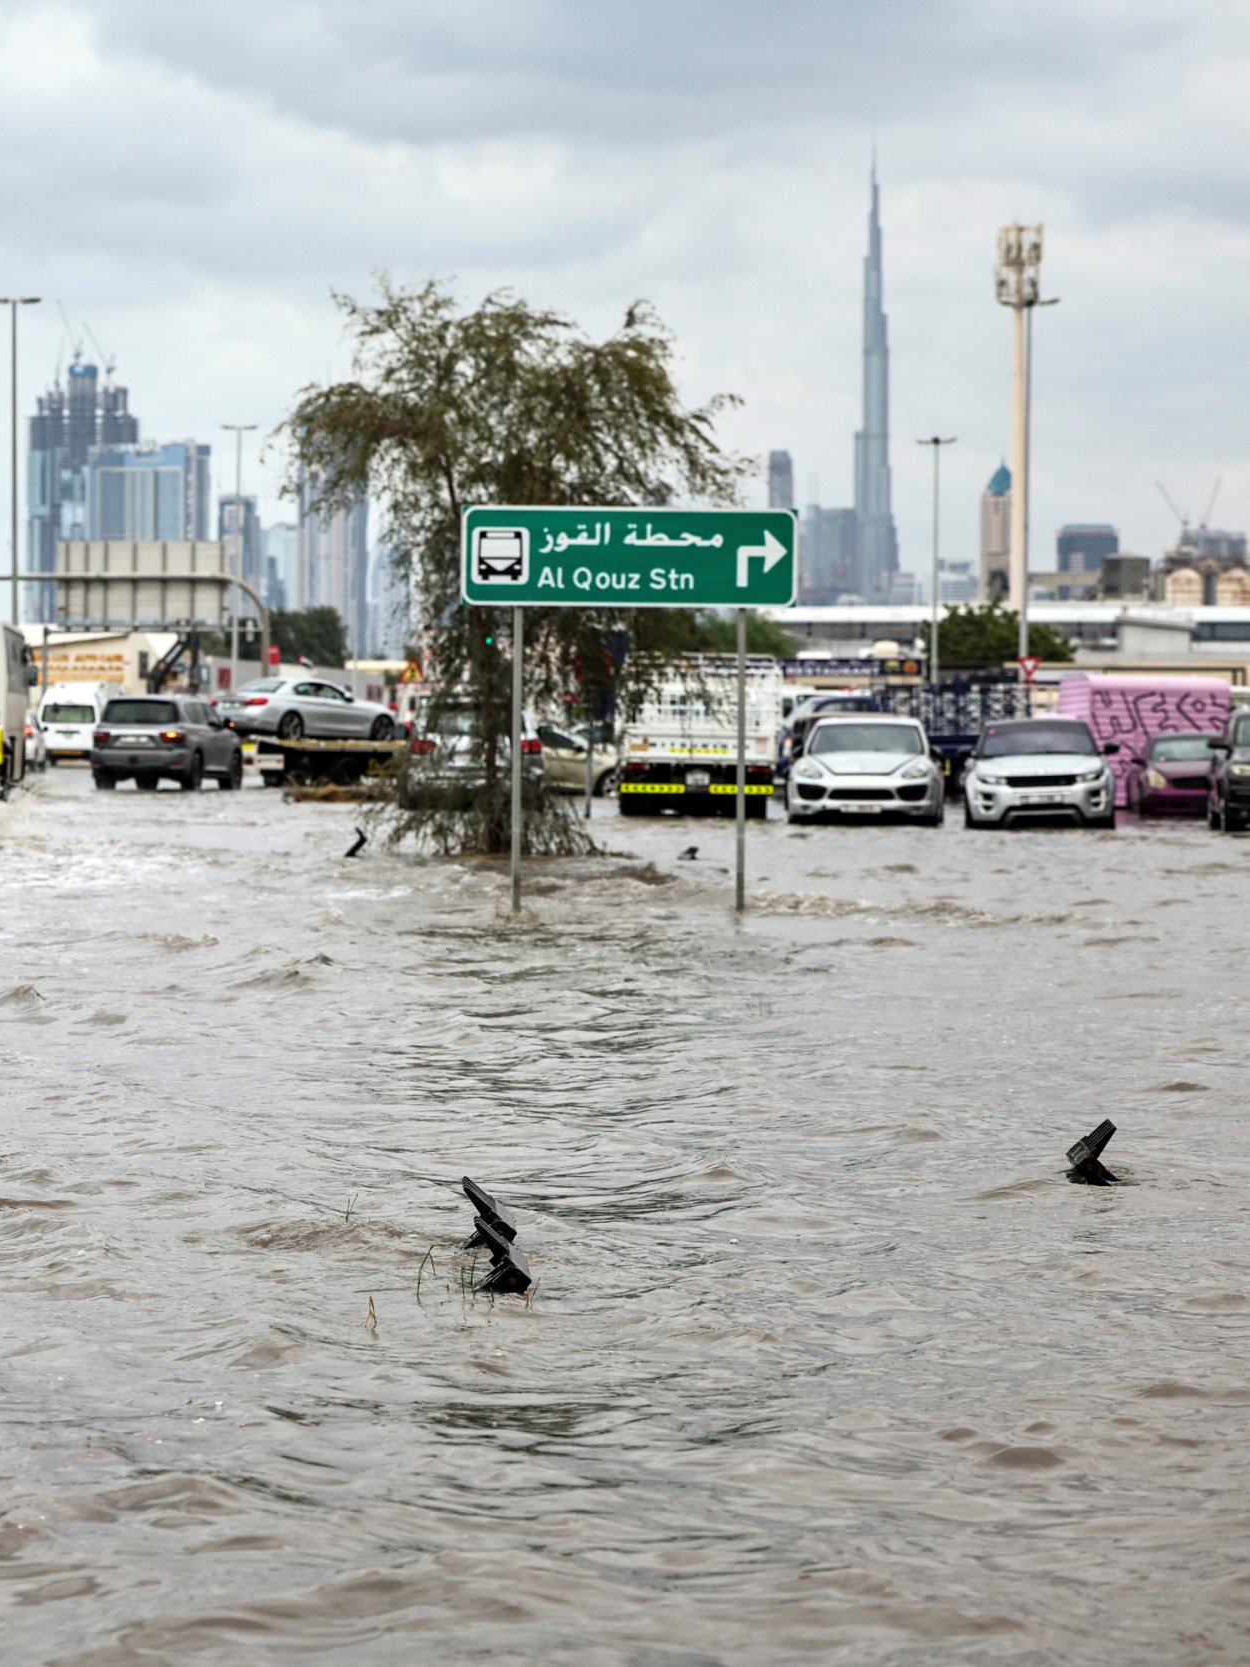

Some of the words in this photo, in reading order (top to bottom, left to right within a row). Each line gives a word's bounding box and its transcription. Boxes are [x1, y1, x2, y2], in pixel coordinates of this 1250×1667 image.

[538, 522, 611, 553] القوز
[623, 522, 724, 548] محطة
[537, 567, 565, 589] Al
[573, 567, 640, 590] Qouz
[649, 568, 694, 590] Stn
